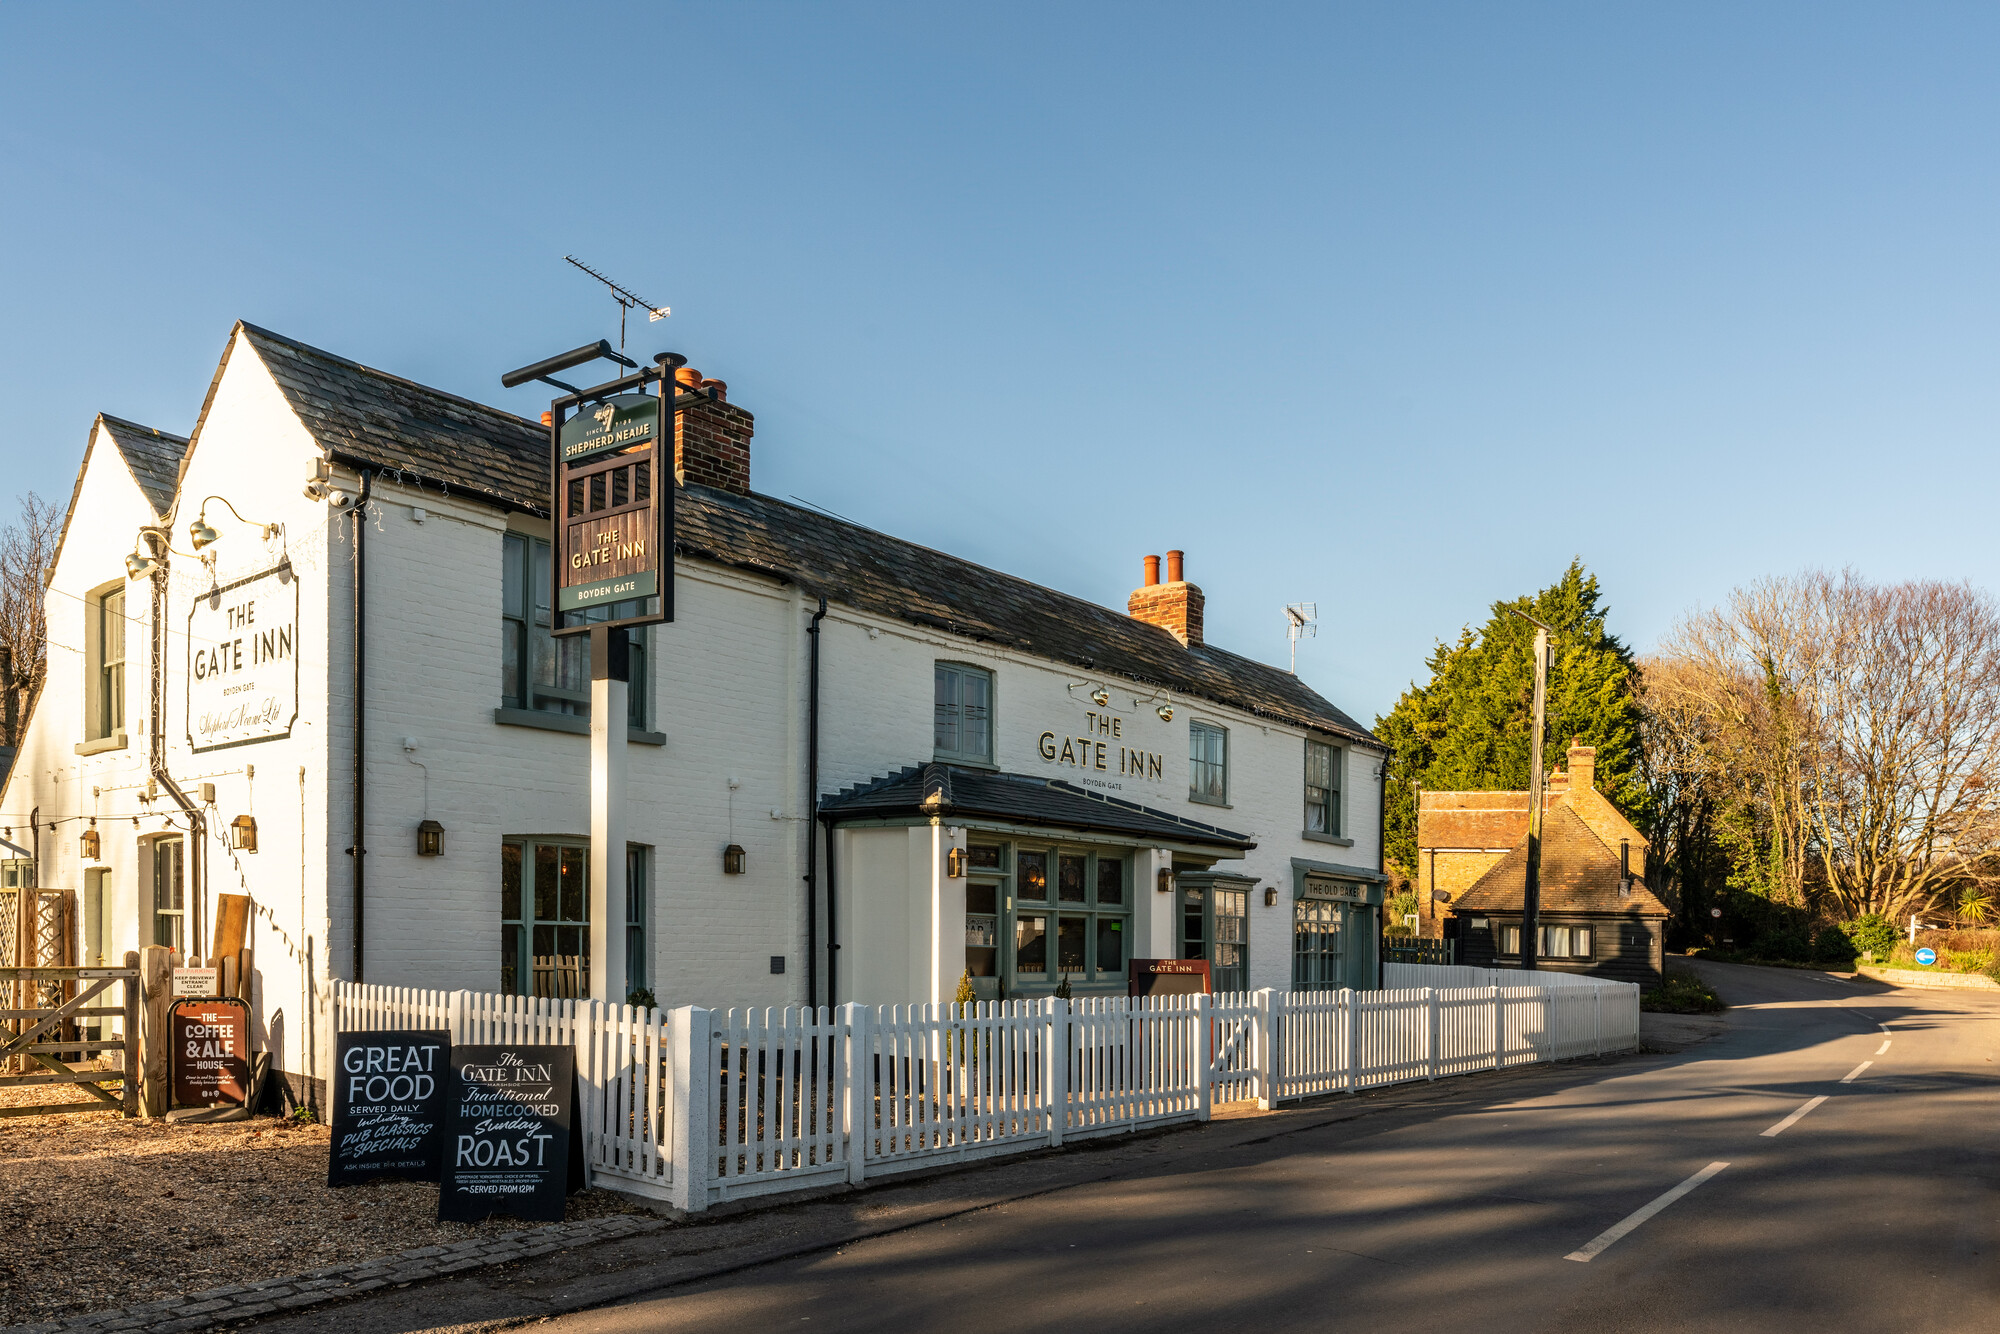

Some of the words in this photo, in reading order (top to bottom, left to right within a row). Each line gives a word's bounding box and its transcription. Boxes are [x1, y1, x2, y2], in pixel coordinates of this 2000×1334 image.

[566, 434, 615, 456] SHEPHERD
[616, 423, 650, 442] NEAME
[586, 427, 603, 436] SINCE
[597, 530, 619, 545] THE
[572, 547, 610, 569] GATE
[617, 539, 645, 560] INN
[578, 586, 611, 600] BOYDEN
[614, 581, 635, 593] GATE
[228, 601, 255, 630] THE
[195, 638, 242, 680] GATE
[254, 623, 292, 665] INN
[223, 685, 242, 696] BOYDEN
[243, 682, 255, 692] GATE
[261, 696, 282, 725] Ltd
[1086, 710, 1122, 738] THE
[1038, 731, 1107, 770] GATE
[1120, 746, 1162, 780] INN
[1082, 778, 1106, 788] BOYDEN
[1107, 782, 1122, 791] GATE
[1309, 883, 1322, 894] THE
[1324, 884, 1338, 896] OLD
[1340, 886, 1365, 898] BAKERY
[201, 1013, 217, 1022] THE
[185, 1024, 234, 1038] COFFEE
[196, 1060, 224, 1070] HOUSE
[343, 1045, 440, 1073] GREAT
[496, 1052, 524, 1067] The
[461, 1064, 507, 1082] GATE
[516, 1064, 552, 1082] INN
[348, 1074, 435, 1103] FOOD
[462, 1086, 553, 1103] Traditional
[350, 1105, 387, 1114] SERVED
[390, 1104, 420, 1112] DAILY
[460, 1104, 559, 1118] HOMECOOKED
[357, 1113, 413, 1128] Including
[475, 1117, 542, 1136] Sunday
[340, 1128, 373, 1147] PUB
[374, 1123, 434, 1138] CLASSICS
[353, 1137, 422, 1158] SPECIALS
[456, 1135, 553, 1167] ROAST
[469, 1185, 498, 1194] SERVED
[498, 1184, 518, 1193] FROM
[519, 1184, 535, 1193] 12PM
